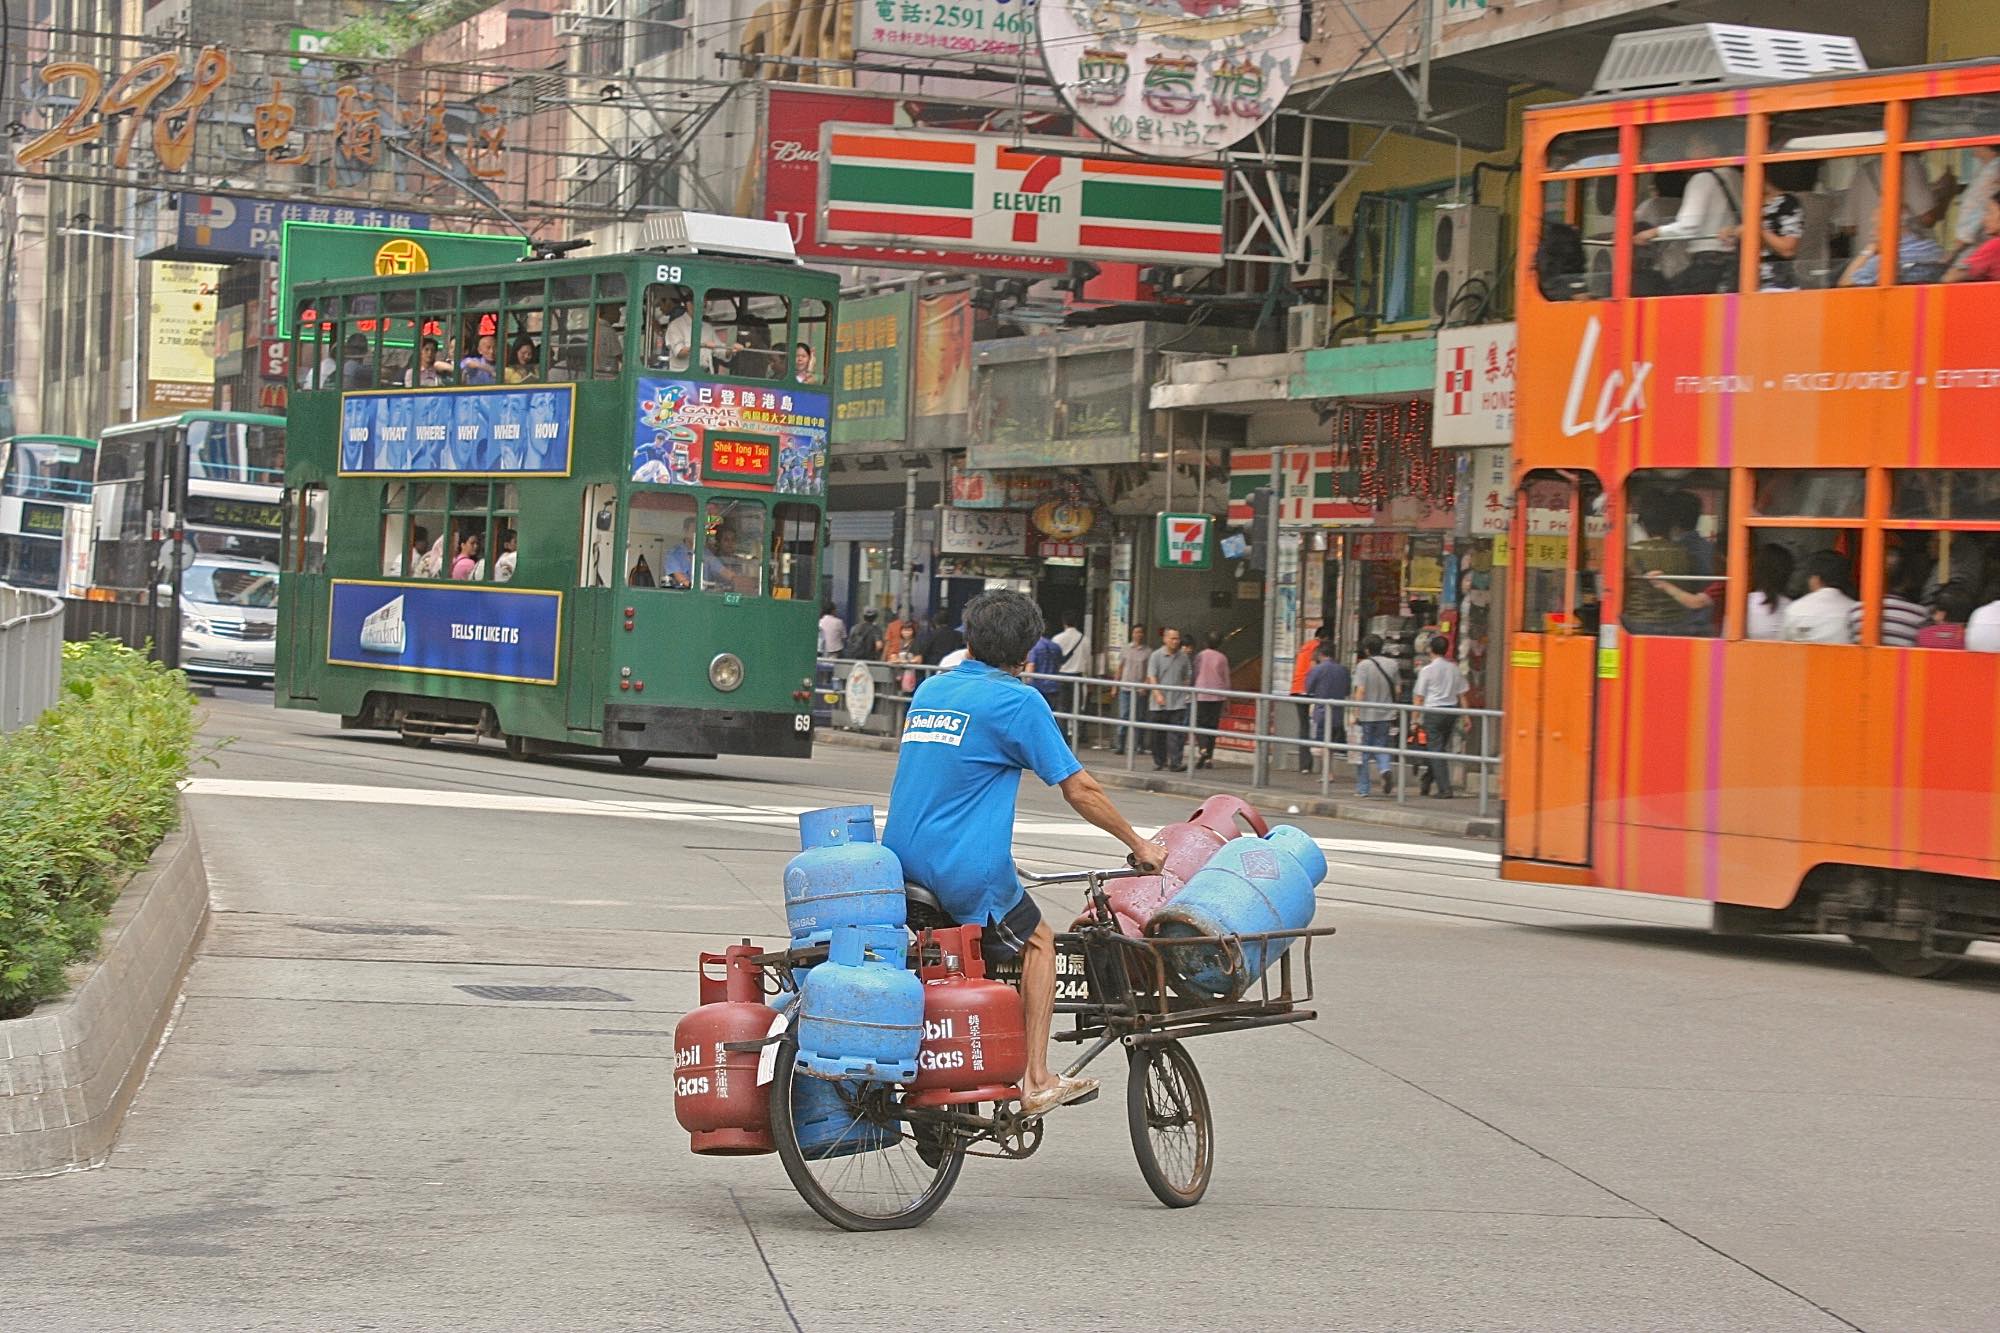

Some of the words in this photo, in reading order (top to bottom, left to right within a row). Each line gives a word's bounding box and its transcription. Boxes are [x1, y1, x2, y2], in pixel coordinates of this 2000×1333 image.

[934, 5, 983, 29] 2591
[993, 13, 1033, 35] 466
[16, 45, 228, 173] 298
[996, 145, 1062, 243] 7
[656, 264, 682, 283] 69
[681, 405, 738, 418] GAME
[350, 427, 369, 442] WHO
[382, 426, 407, 441] WHAT
[416, 425, 446, 440] WHERE
[458, 425, 480, 440] WHY
[494, 423, 520, 439] WHEN
[535, 423, 559, 439] HOW
[714, 440, 732, 452] Shek
[735, 443, 752, 456] Tong
[754, 444, 769, 456] Tsui
[451, 623, 474, 640] TELLS
[483, 625, 501, 642] LIKE
[795, 714, 811, 732] 69
[921, 1018, 952, 1040] bil
[673, 1044, 701, 1069] obil
[920, 1050, 964, 1070] Gas
[677, 1076, 709, 1097] Gas
